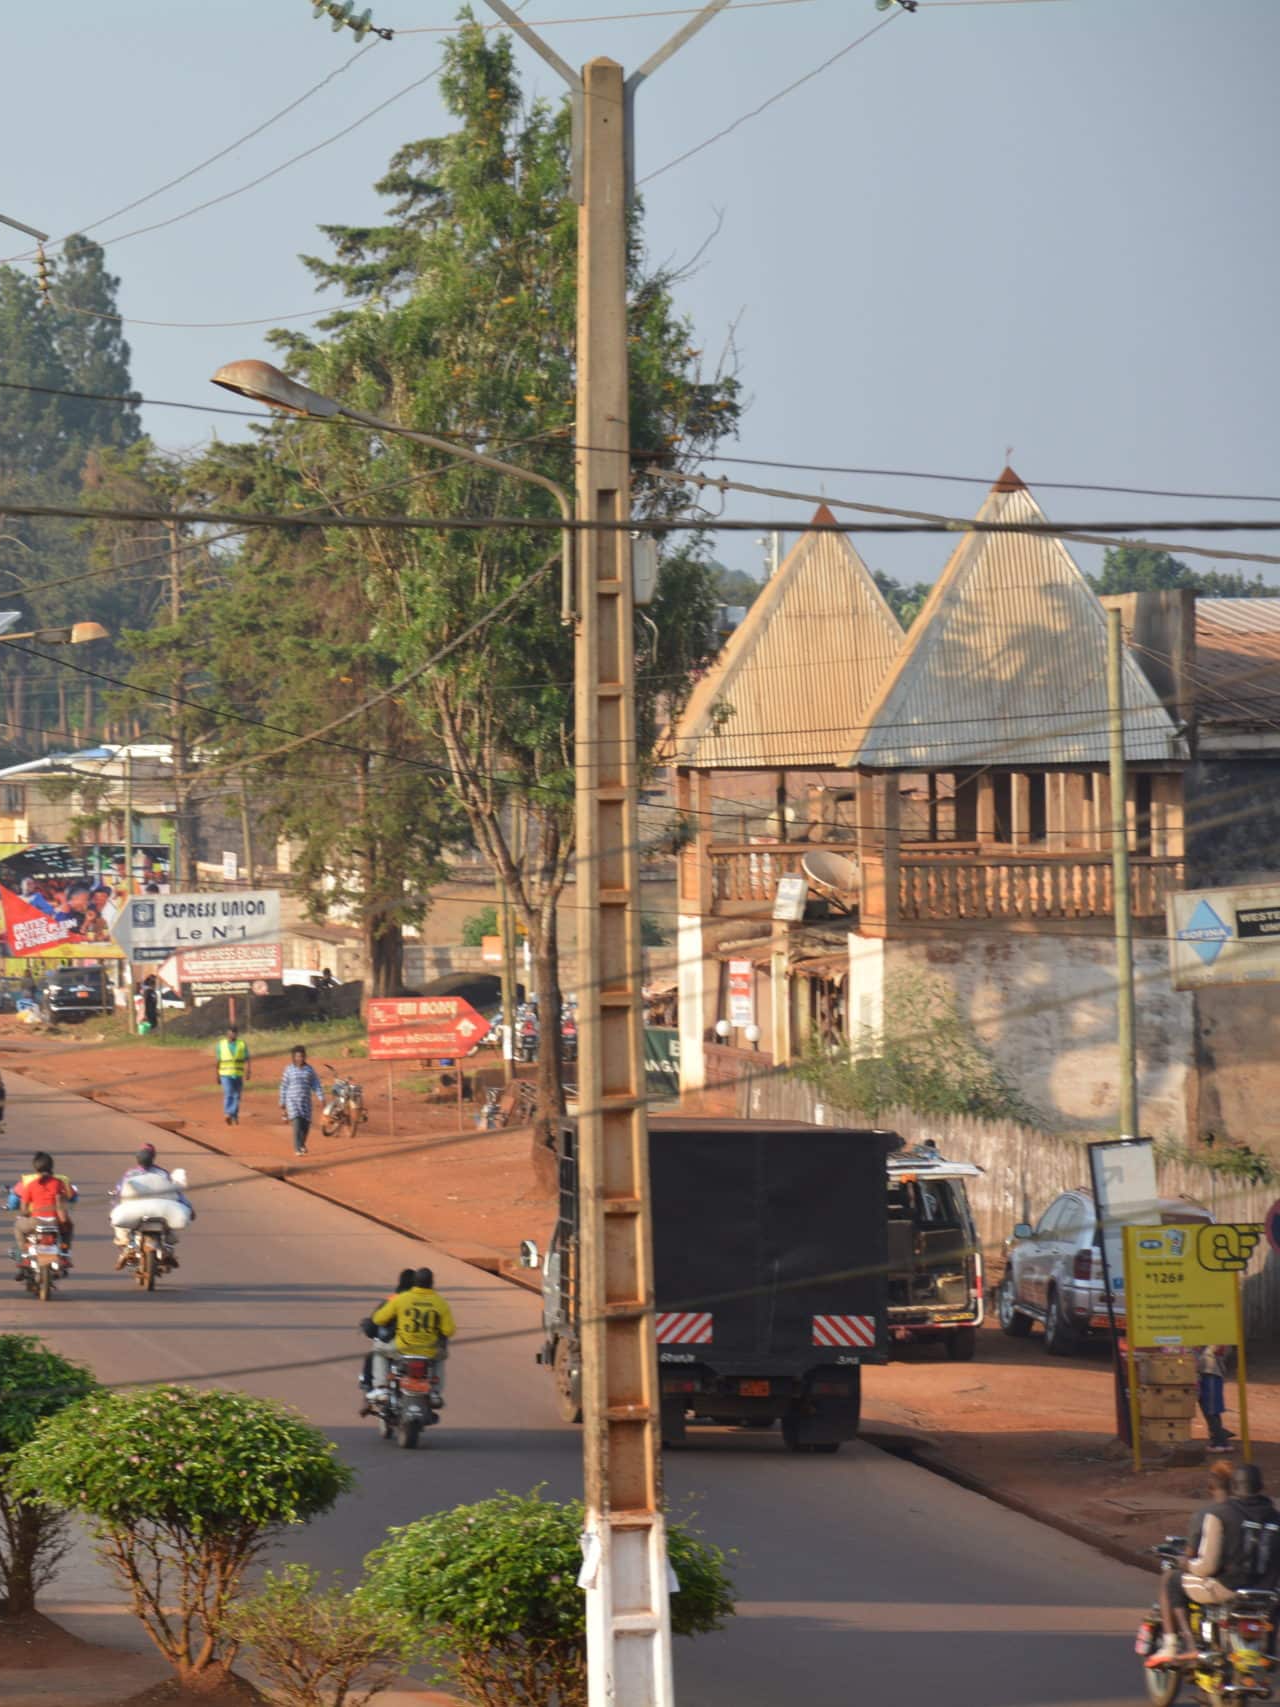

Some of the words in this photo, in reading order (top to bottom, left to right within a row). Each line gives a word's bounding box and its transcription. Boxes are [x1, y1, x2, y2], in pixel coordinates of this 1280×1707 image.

[163, 901, 216, 918] EXPRESS
[222, 899, 266, 916] UNION
[176, 927, 202, 940] Le
